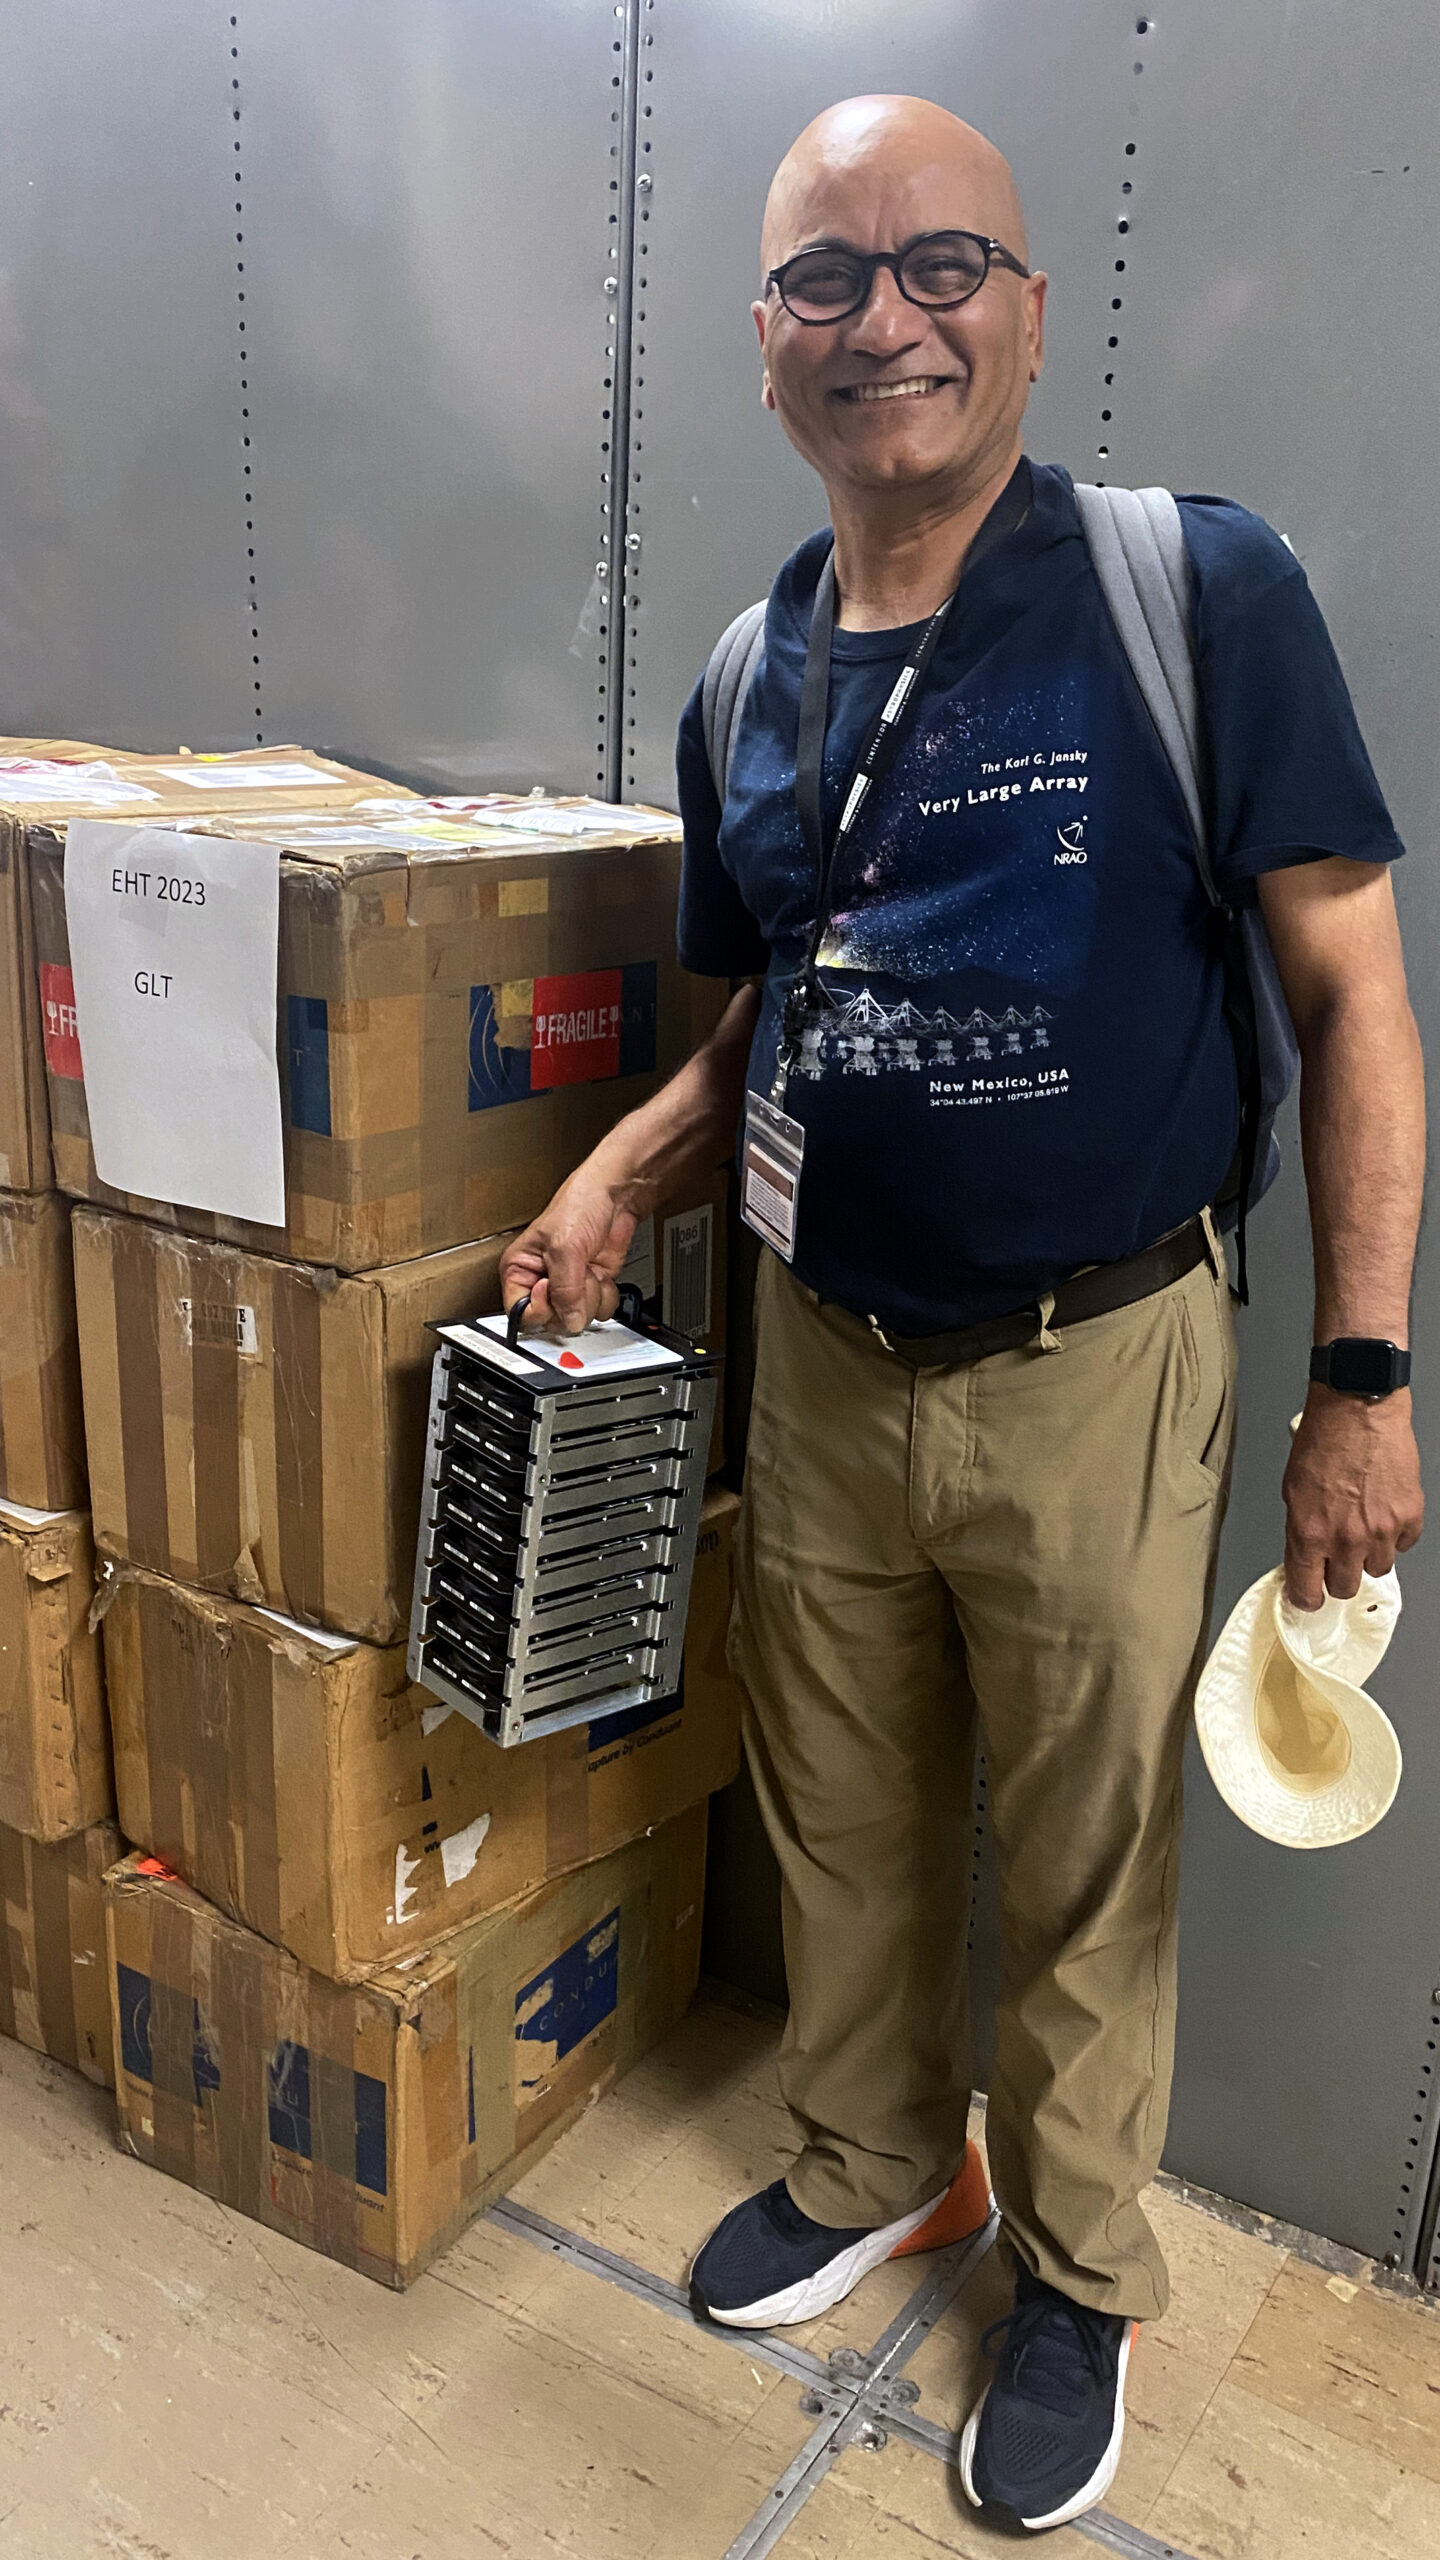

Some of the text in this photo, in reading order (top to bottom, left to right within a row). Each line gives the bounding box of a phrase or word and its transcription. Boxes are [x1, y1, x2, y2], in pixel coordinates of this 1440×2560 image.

[865, 738, 881, 765] CENTER
[981, 750, 1088, 775] The Karl G. Jansky
[918, 776, 1089, 816] Very Large Array
[1053, 852, 1088, 866] NRAO
[112, 869, 206, 906] EHT 2023
[134, 971, 173, 999] GLT
[547, 1007, 607, 1047] FRAGILE
[929, 1068, 1069, 1093] New Mexico, USA
[985, 1096, 993, 1104] N
[1060, 1085, 1069, 1093] W
[679, 1224, 698, 1244] 086
[587, 1749, 620, 1773] apture
